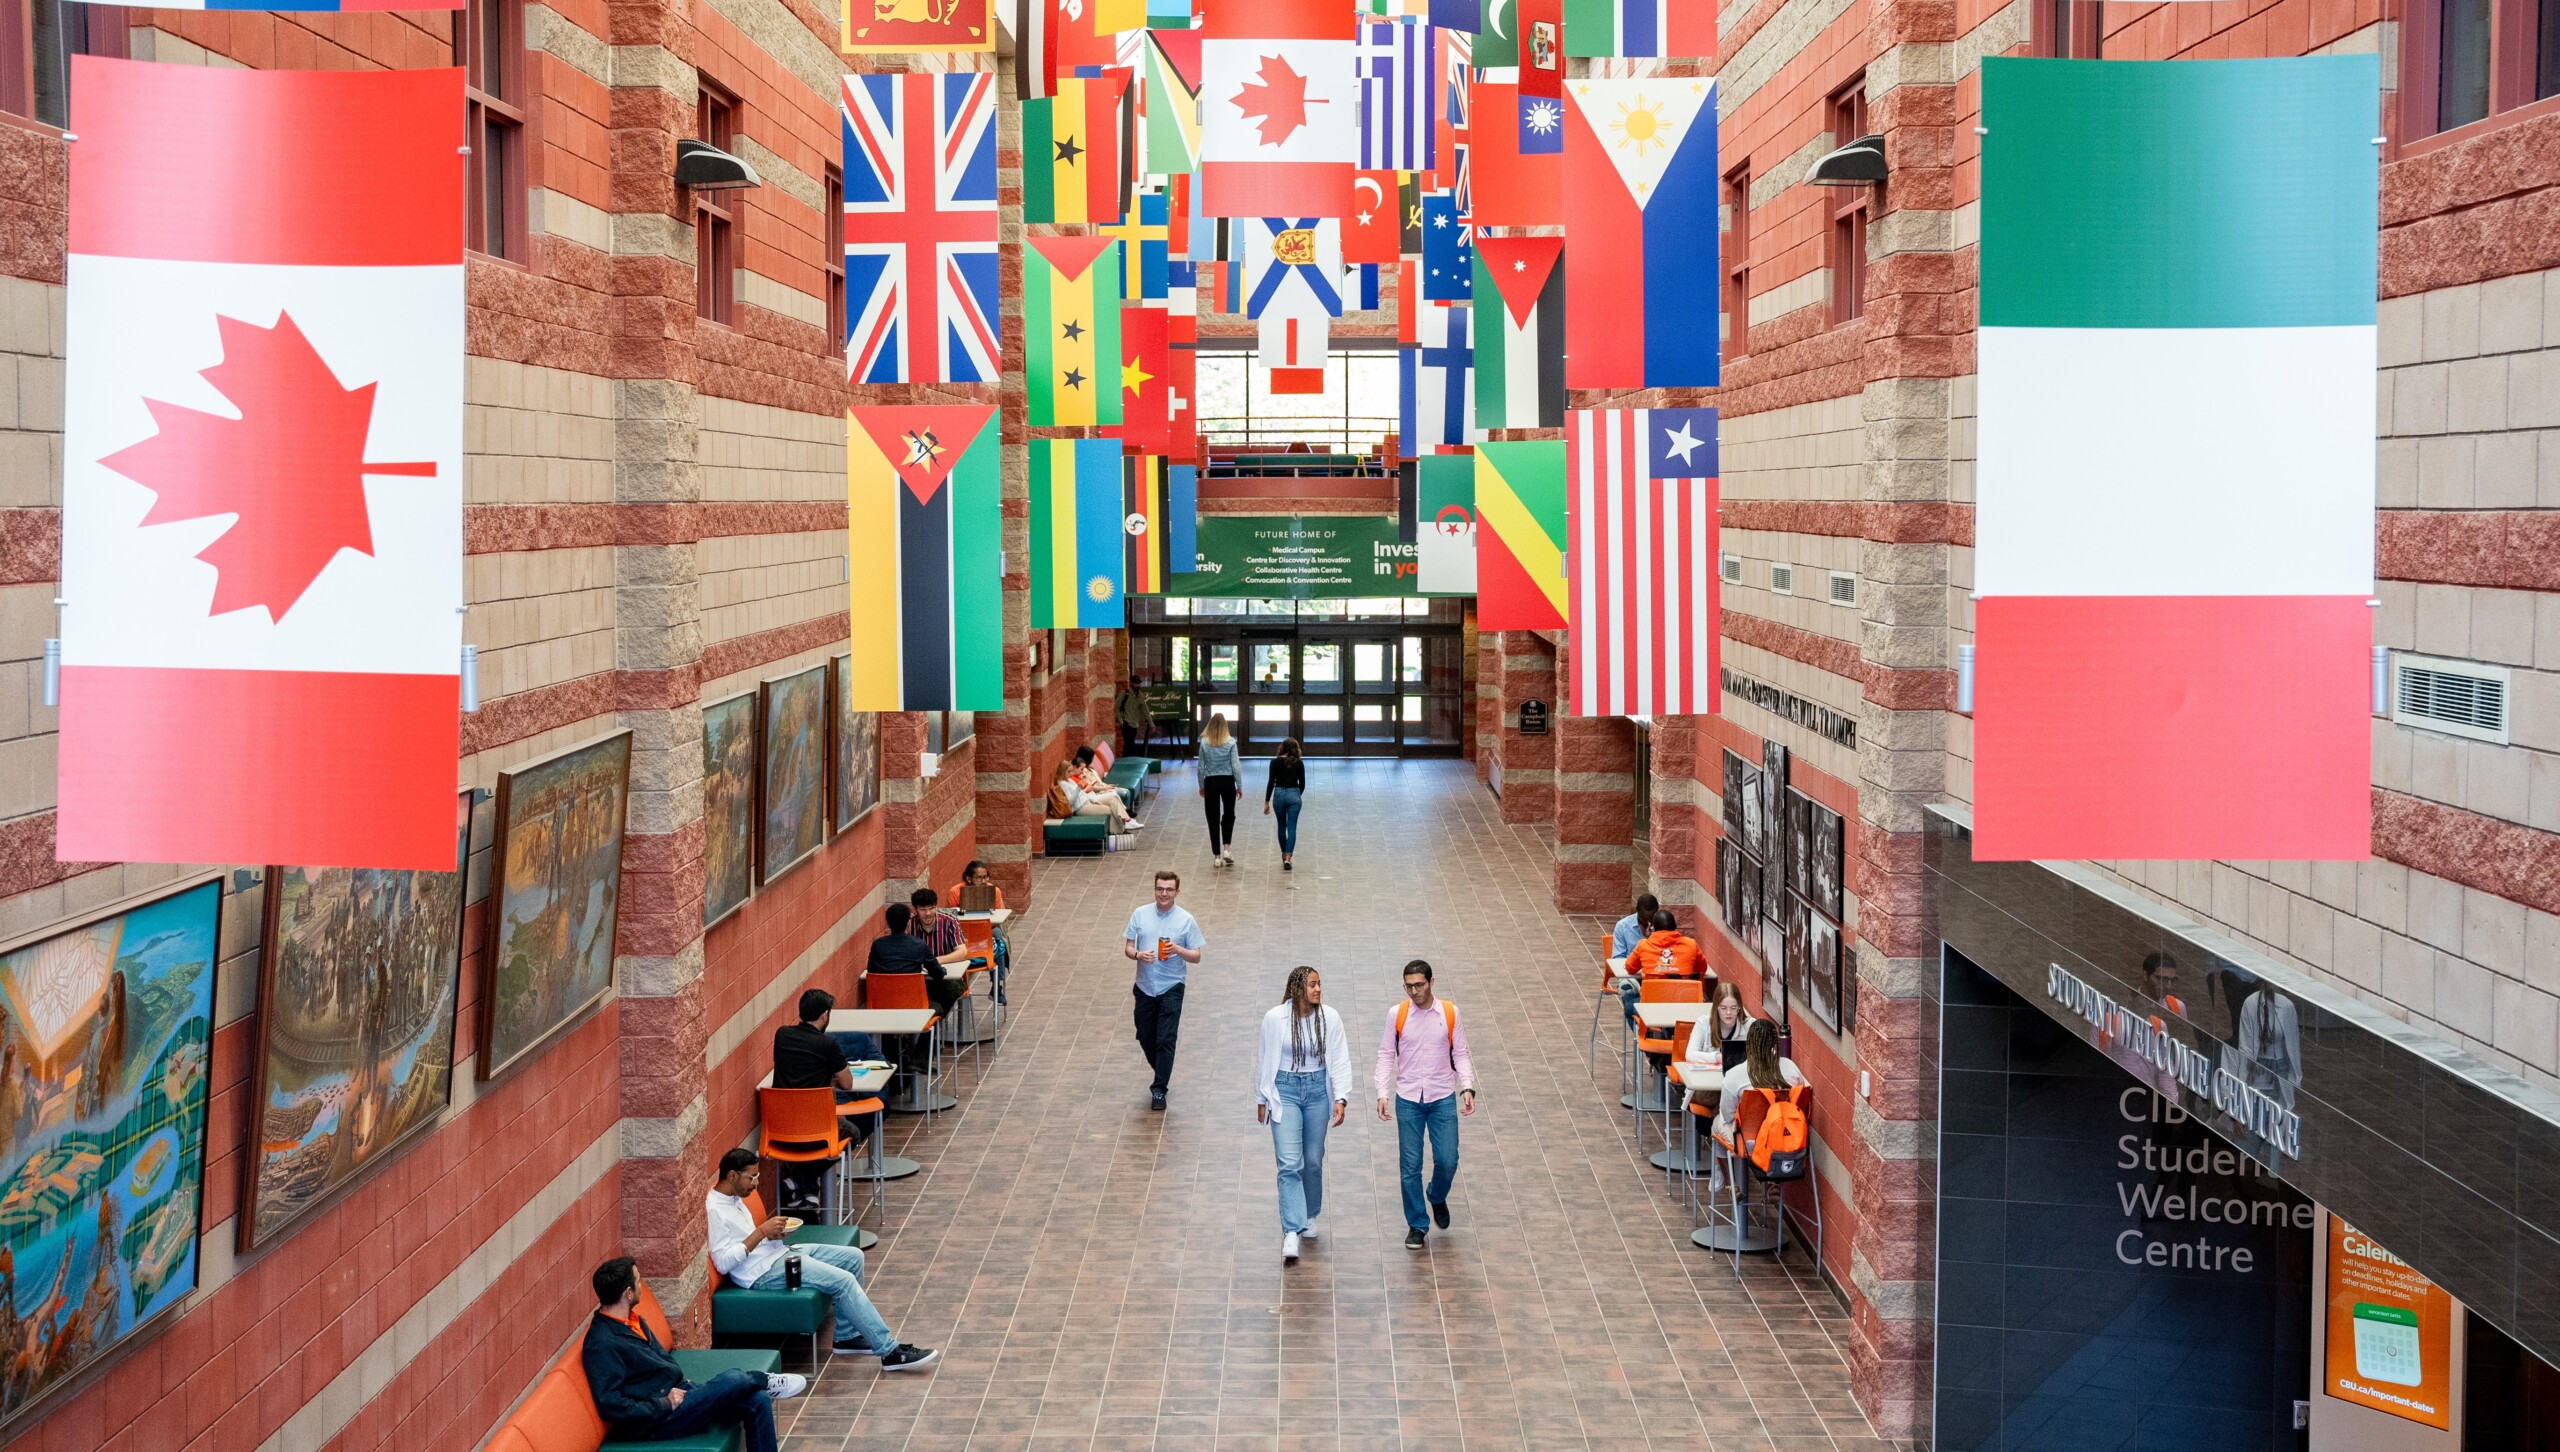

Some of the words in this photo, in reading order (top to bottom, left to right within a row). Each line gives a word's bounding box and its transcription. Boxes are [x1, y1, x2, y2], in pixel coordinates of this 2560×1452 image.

[1255, 531, 1289, 539] FUTURE
[1292, 531, 1321, 539] HOME
[1324, 531, 1337, 539] OF
[1246, 556, 1268, 564] Centre
[1268, 556, 1278, 564] for
[1278, 556, 1310, 565] Discovery
[1311, 556, 1317, 564] &
[1317, 556, 1351, 564] Innovation
[1272, 546, 1298, 554] Medical
[1298, 546, 1325, 555] Campus
[1255, 566, 1298, 574] Collaborative
[1298, 566, 1320, 574] Health
[1320, 566, 1342, 574] Centre
[1374, 559, 1391, 575] in
[1245, 576, 1286, 584] Convocation
[1286, 576, 1292, 584] &
[1292, 576, 1330, 584] Convention
[1330, 576, 1352, 584] Centre
[1799, 698, 1819, 732] WILL
[1819, 706, 1857, 750] TRIUMPH
[2047, 962, 2118, 1038] STUDENT
[2118, 1004, 2211, 1100] WELCOME
[2212, 1067, 2300, 1161] CENTRE
[2117, 1135, 2277, 1179] Studen
[2116, 1182, 2315, 1229] Welcome
[2116, 1229, 2254, 1273] Centre
[2342, 1258, 2354, 1267] will
[2354, 1259, 2369, 1271] help
[2370, 1265, 2382, 1274] you
[2383, 1268, 2396, 1278] stay
[2342, 1268, 2351, 1276] on
[2386, 1278, 2413, 1292] holidays
[2413, 1285, 2427, 1295] and
[2342, 1277, 2359, 1287] other
[2360, 1281, 2392, 1296] important
[2392, 1289, 2412, 1301] dates.
[2368, 1309, 2389, 1317] IMPORTANT
[2340, 1379, 2435, 1414] CBU.ca/important-dates
